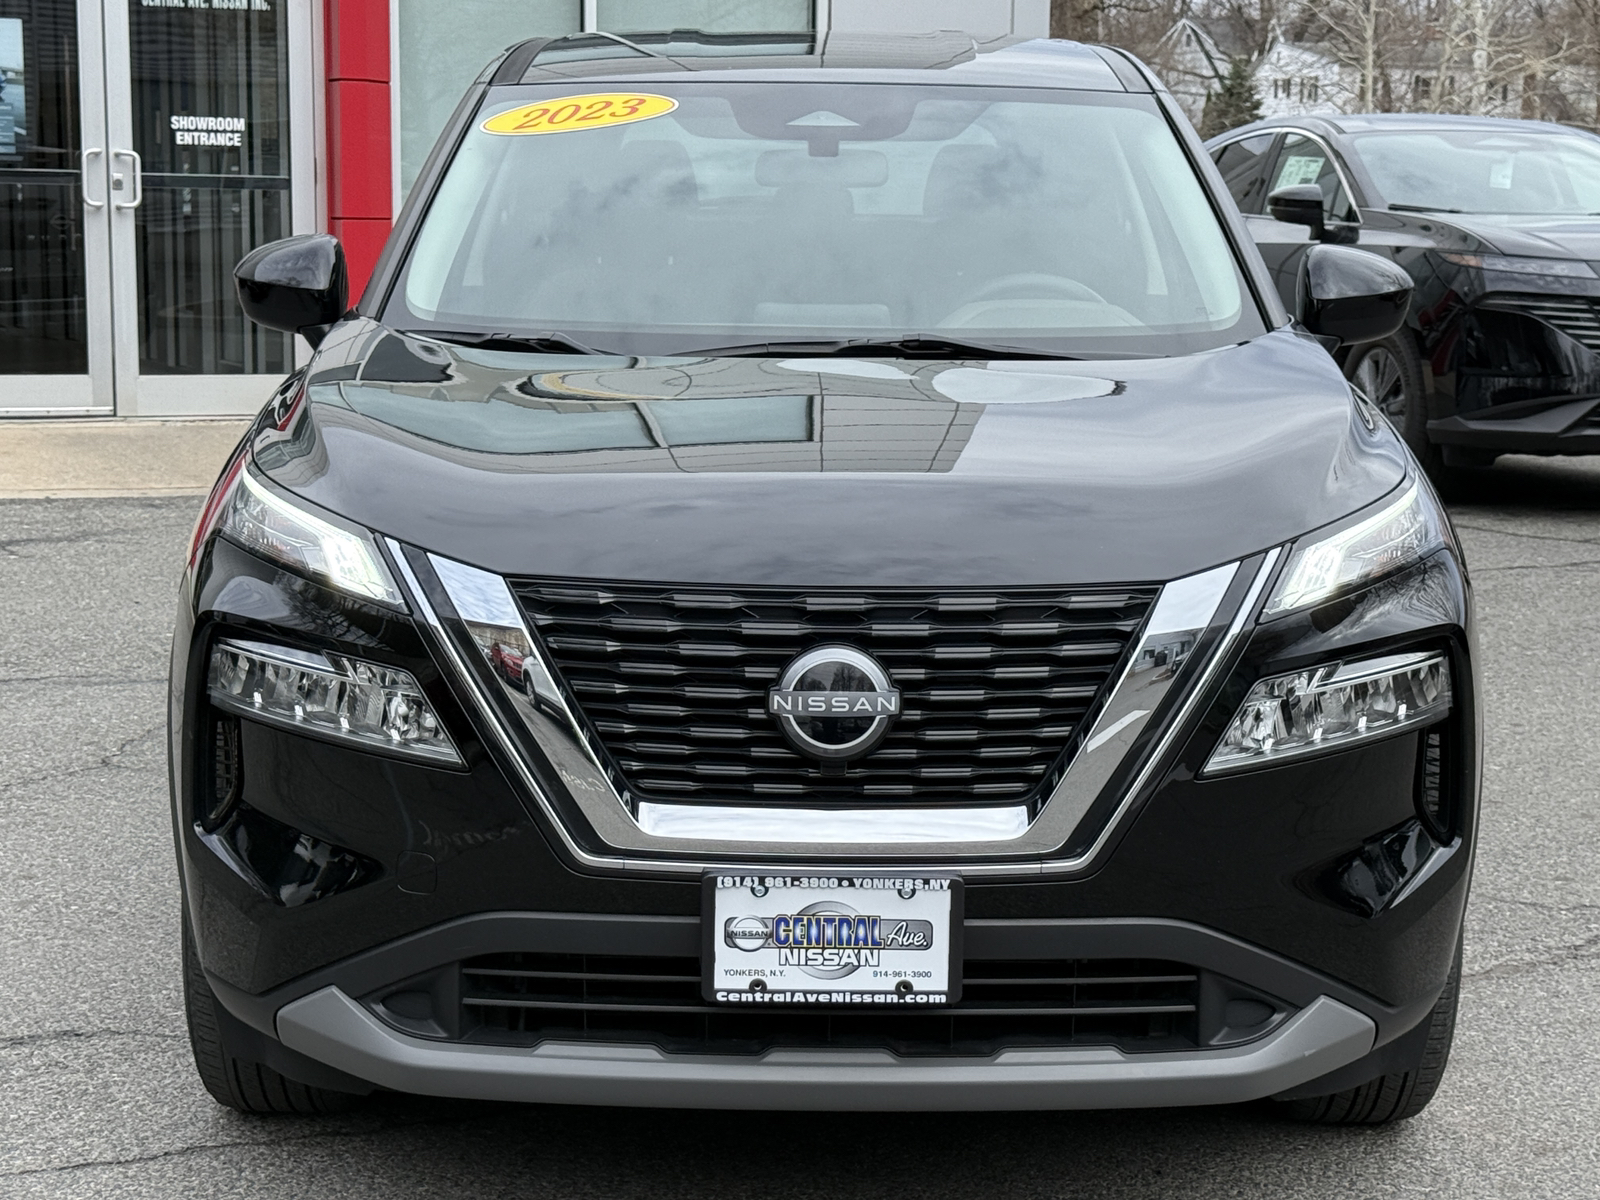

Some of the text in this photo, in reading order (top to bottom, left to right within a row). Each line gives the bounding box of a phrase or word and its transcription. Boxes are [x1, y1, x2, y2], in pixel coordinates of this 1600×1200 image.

[512, 98, 646, 130] 2023
[170, 116, 246, 132] SHOWROOM
[175, 131, 242, 147] ENTRANCE
[773, 694, 896, 712] NISSAN
[717, 876, 759, 889] (914)
[764, 877, 839, 889] 961-3900
[730, 929, 768, 938] NISSAN
[772, 914, 928, 949] CENTRAL Ave.
[779, 948, 880, 966] NISSAN
[723, 968, 786, 978] YONKERS, N.Y.
[872, 970, 932, 978] 914-961-3900
[716, 991, 946, 1004] CentralAveNissan.com
